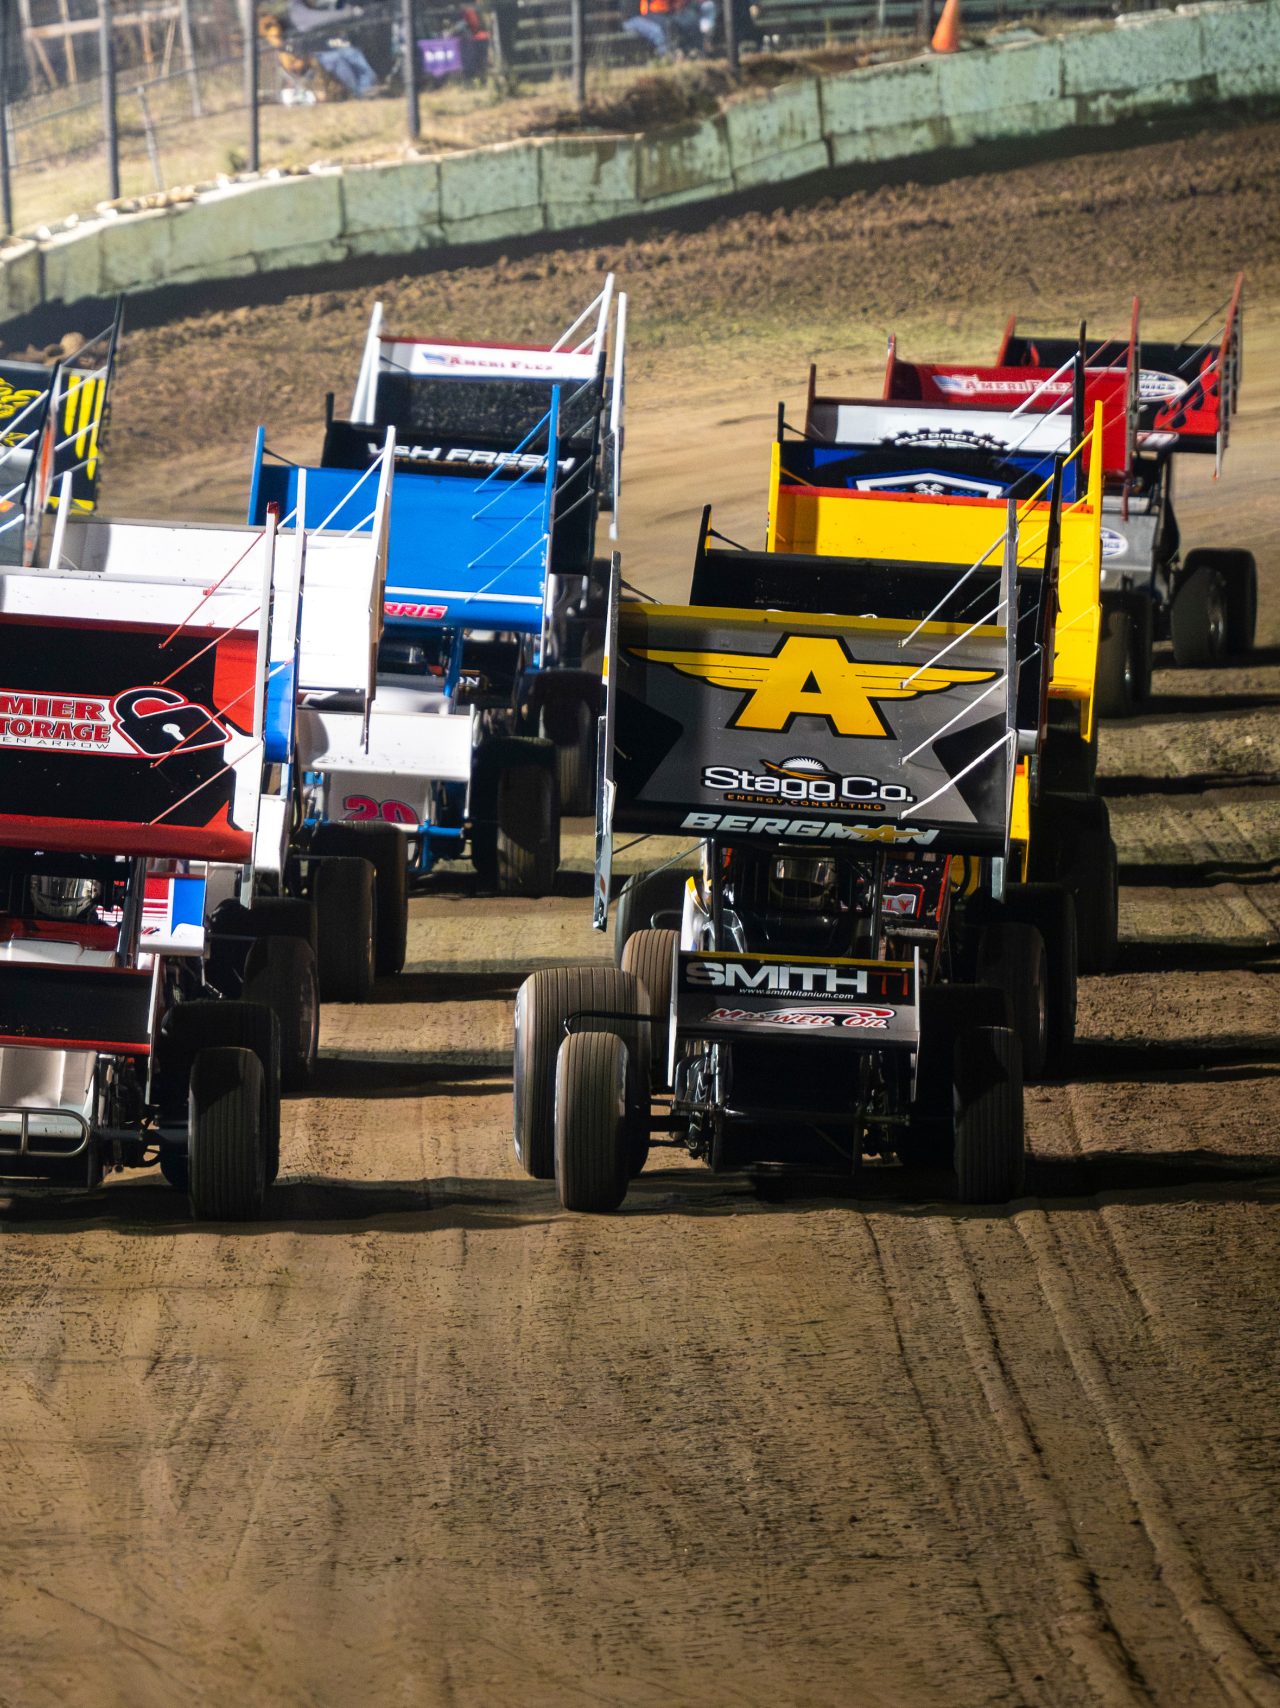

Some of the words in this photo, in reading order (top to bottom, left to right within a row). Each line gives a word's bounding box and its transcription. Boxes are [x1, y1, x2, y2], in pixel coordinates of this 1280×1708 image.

[37, 739, 109, 749] ARROW
[705, 766, 836, 801] Stagg
[841, 776, 913, 802] Co.
[727, 794, 783, 804] ENERGY
[791, 801, 883, 811] CONSULTING
[680, 812, 940, 845] BERGMAN
[686, 962, 868, 993] SMITH
[739, 988, 854, 1000] www.smithtitanium.com
